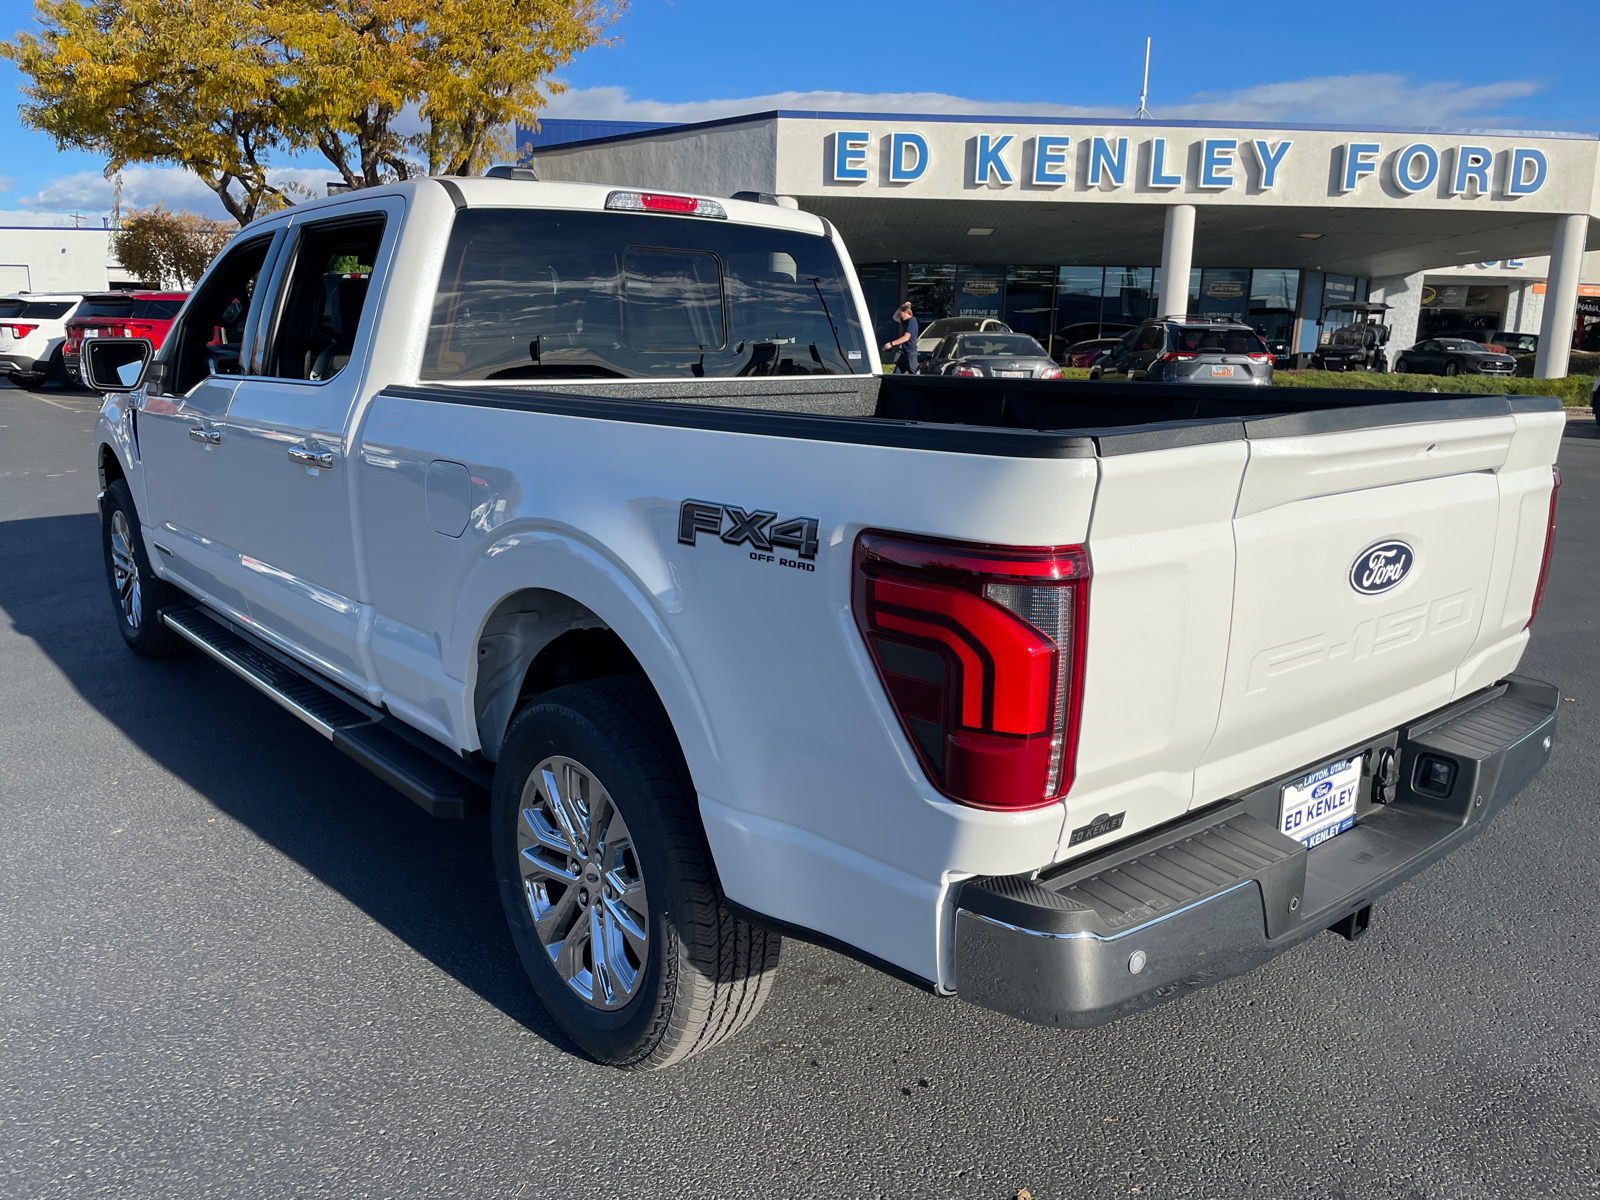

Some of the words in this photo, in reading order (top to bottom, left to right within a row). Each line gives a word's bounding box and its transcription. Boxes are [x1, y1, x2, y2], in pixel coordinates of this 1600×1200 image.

[833, 130, 929, 183] ED
[974, 133, 1295, 190] KENLEY
[1339, 142, 1549, 197] FORD
[677, 497, 821, 561] FX4
[749, 551, 775, 563] OFF
[779, 557, 815, 573] ROAD
[1246, 588, 1476, 696] F-150
[1330, 760, 1346, 775] UTAH
[1285, 809, 1302, 832] ED
[1306, 785, 1355, 822] KENLEY
[1070, 831, 1083, 844] ED
[1085, 816, 1124, 838] KENLEY
[1309, 822, 1341, 848] KENLEY
